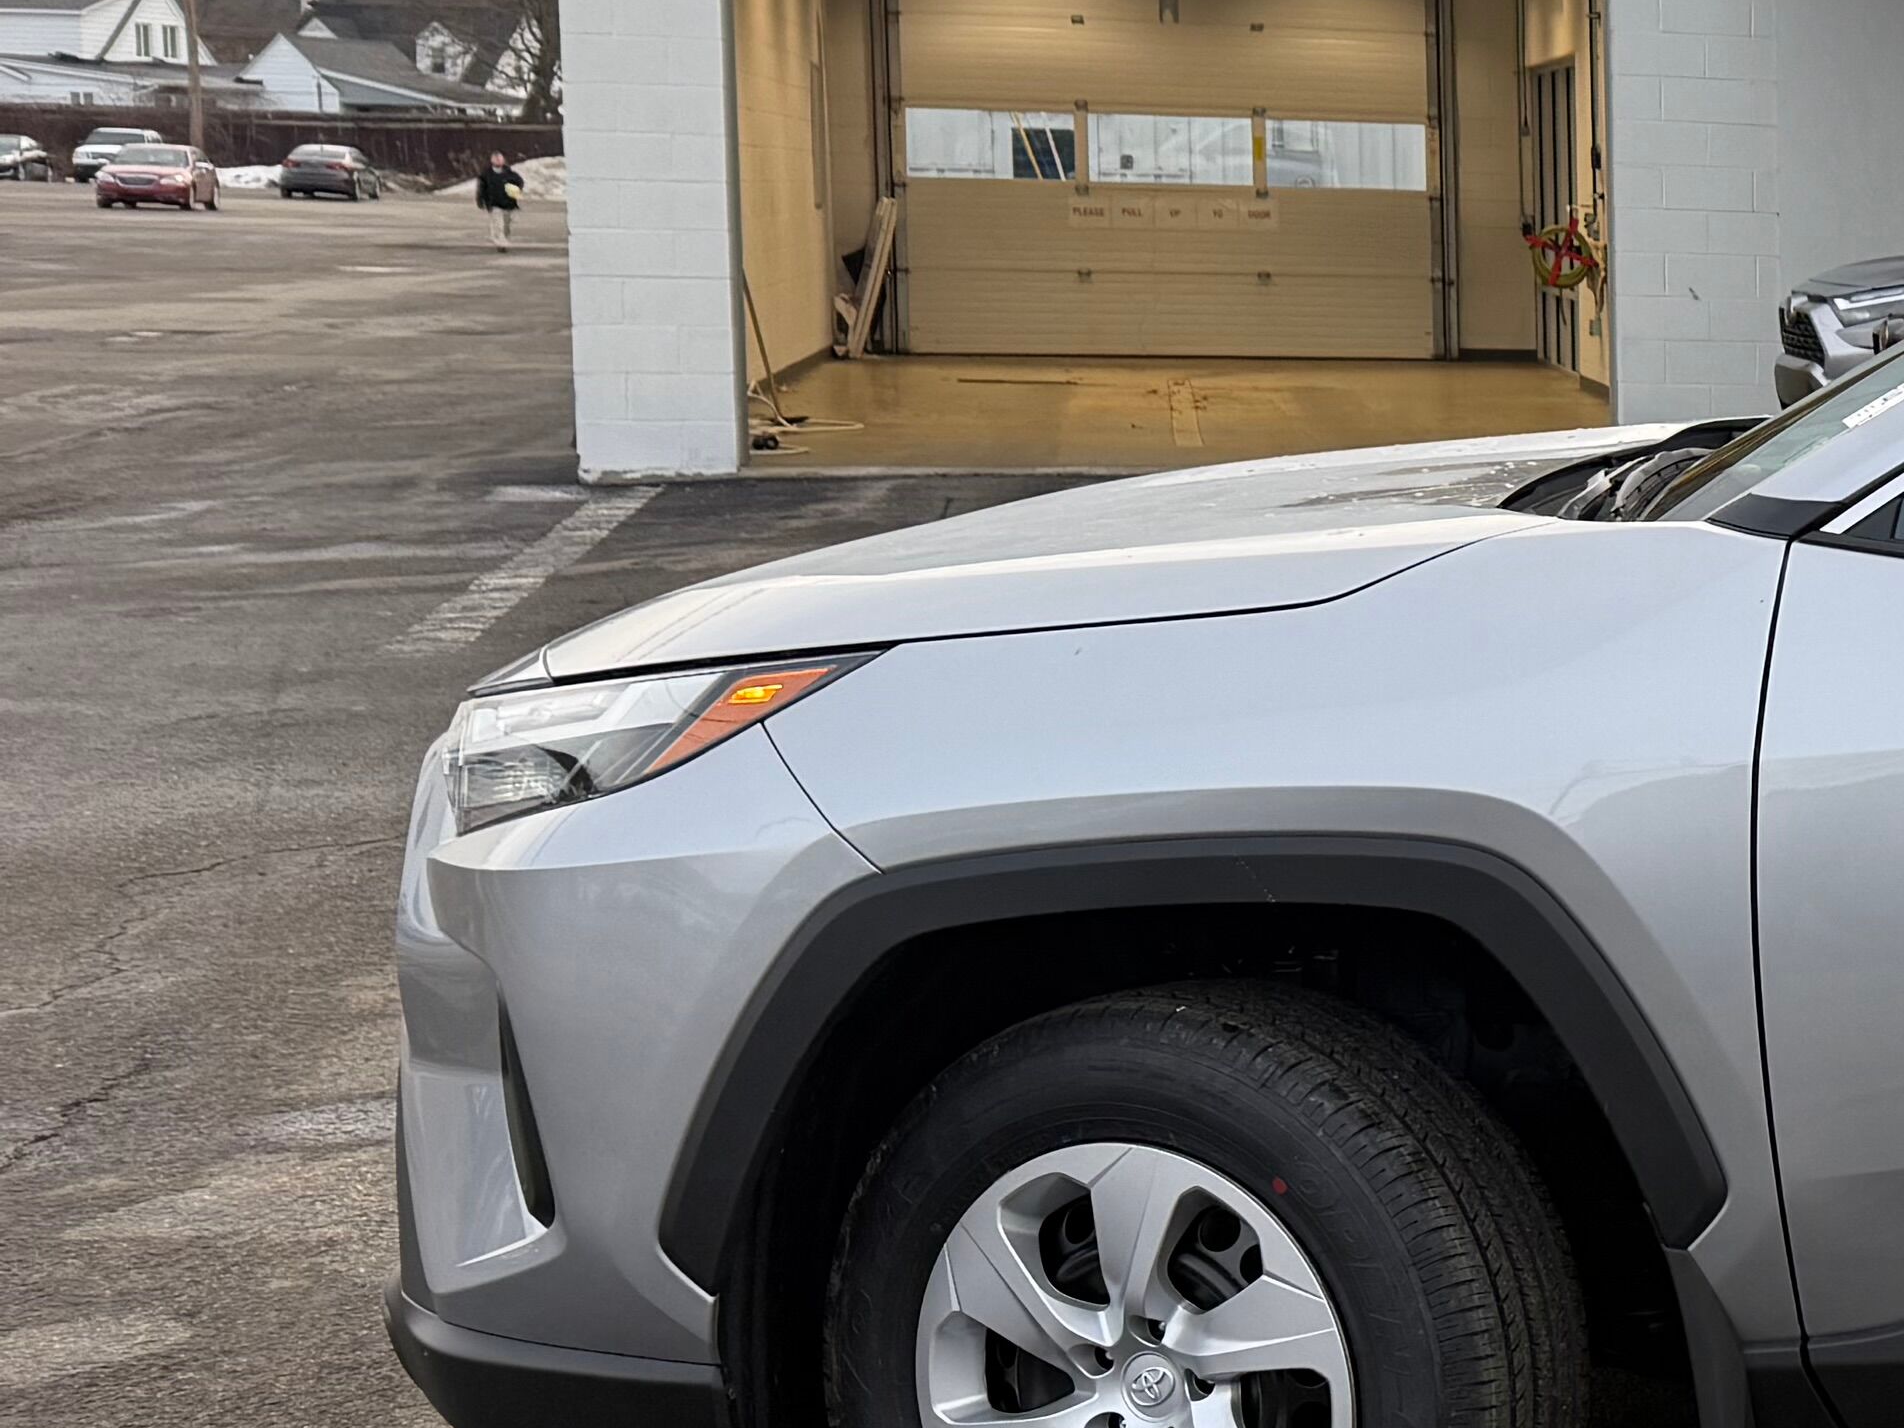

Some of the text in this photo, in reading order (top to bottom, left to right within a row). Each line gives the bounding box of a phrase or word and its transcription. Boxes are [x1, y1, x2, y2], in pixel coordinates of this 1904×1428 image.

[1072, 206, 1105, 218] PLEASE
[1121, 207, 1143, 218] PULL
[1247, 209, 1271, 220] DOOR
